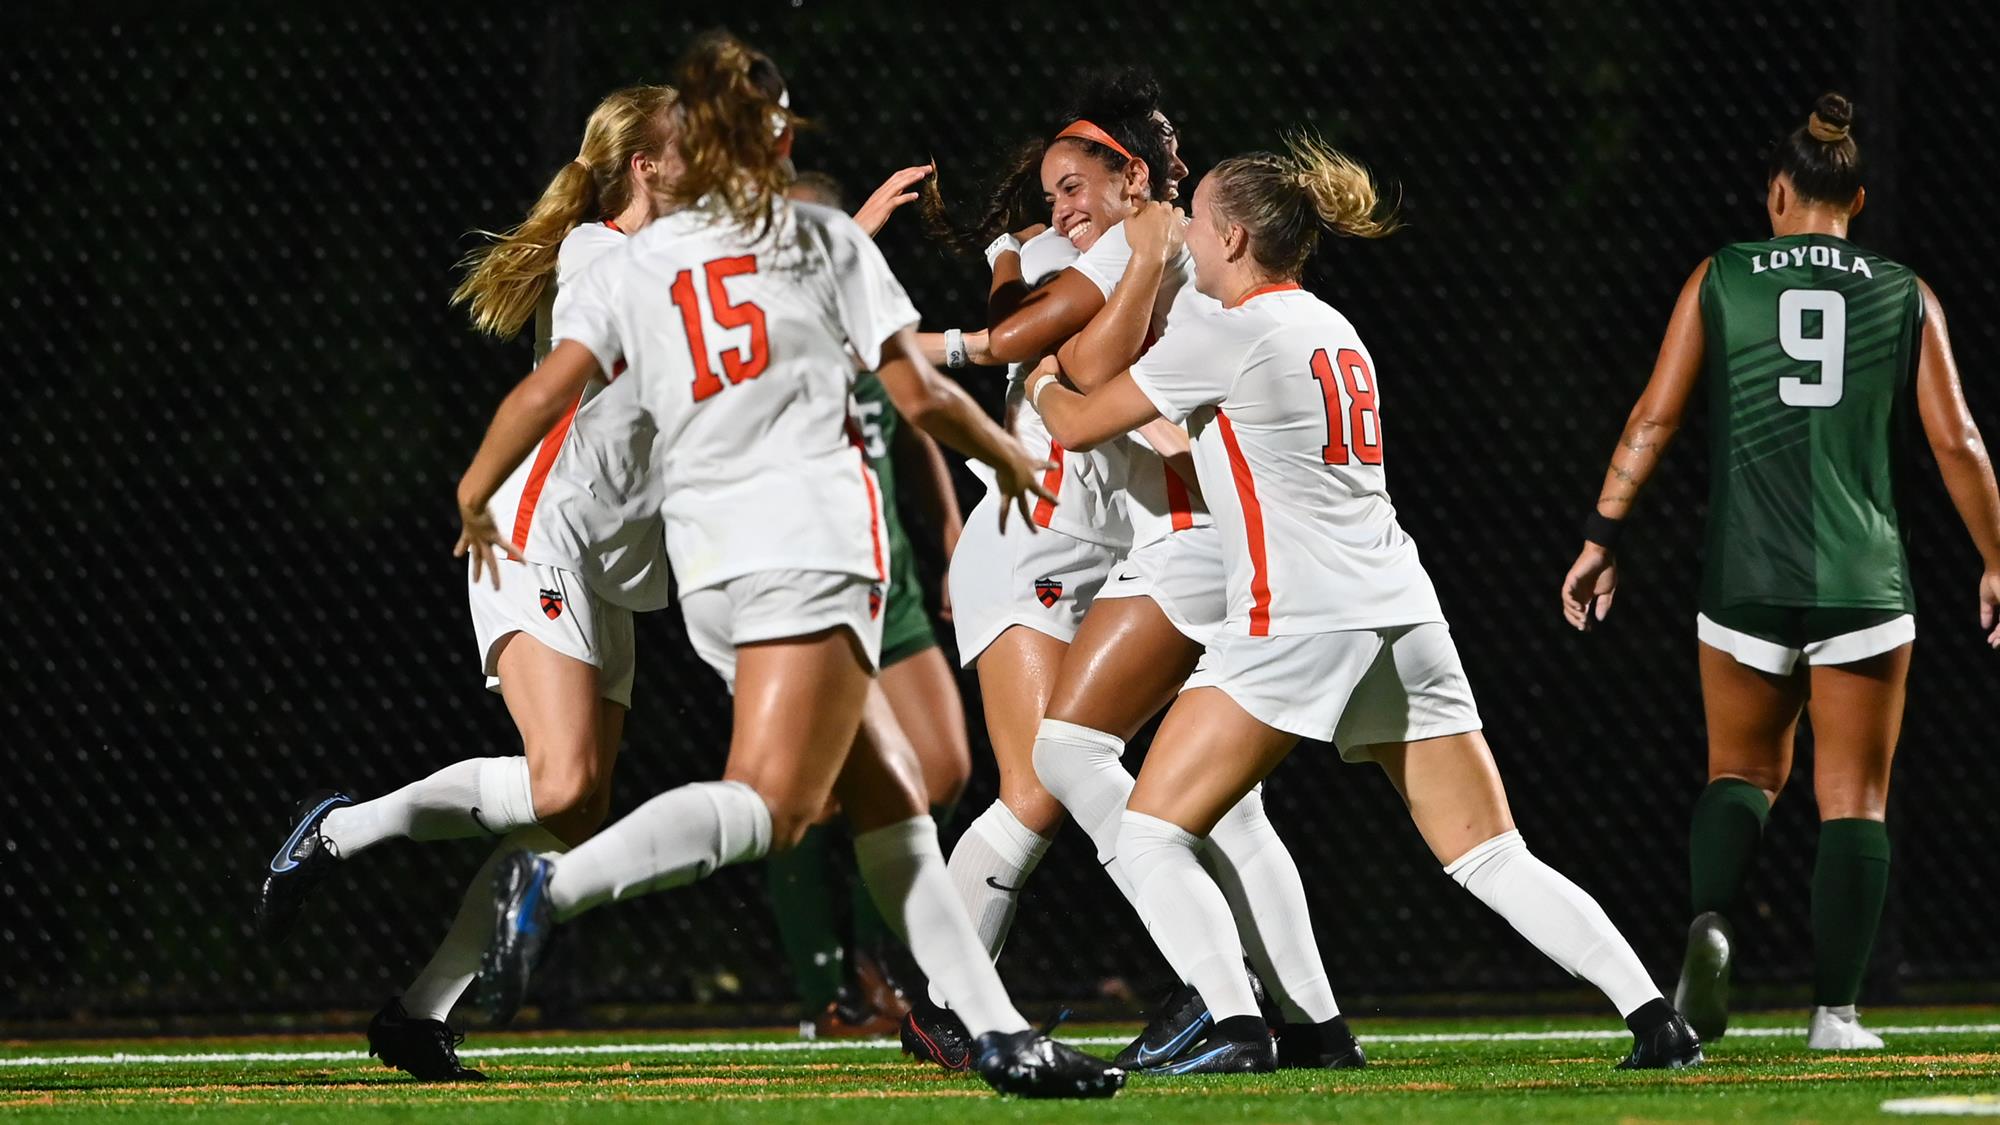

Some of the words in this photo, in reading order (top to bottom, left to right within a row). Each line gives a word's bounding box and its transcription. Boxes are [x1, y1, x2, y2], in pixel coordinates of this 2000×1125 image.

[1751, 245, 1873, 279] LOYOLA
[669, 254, 770, 404] 15
[1778, 288, 1846, 407] 9
[1308, 348, 1382, 466] 18
